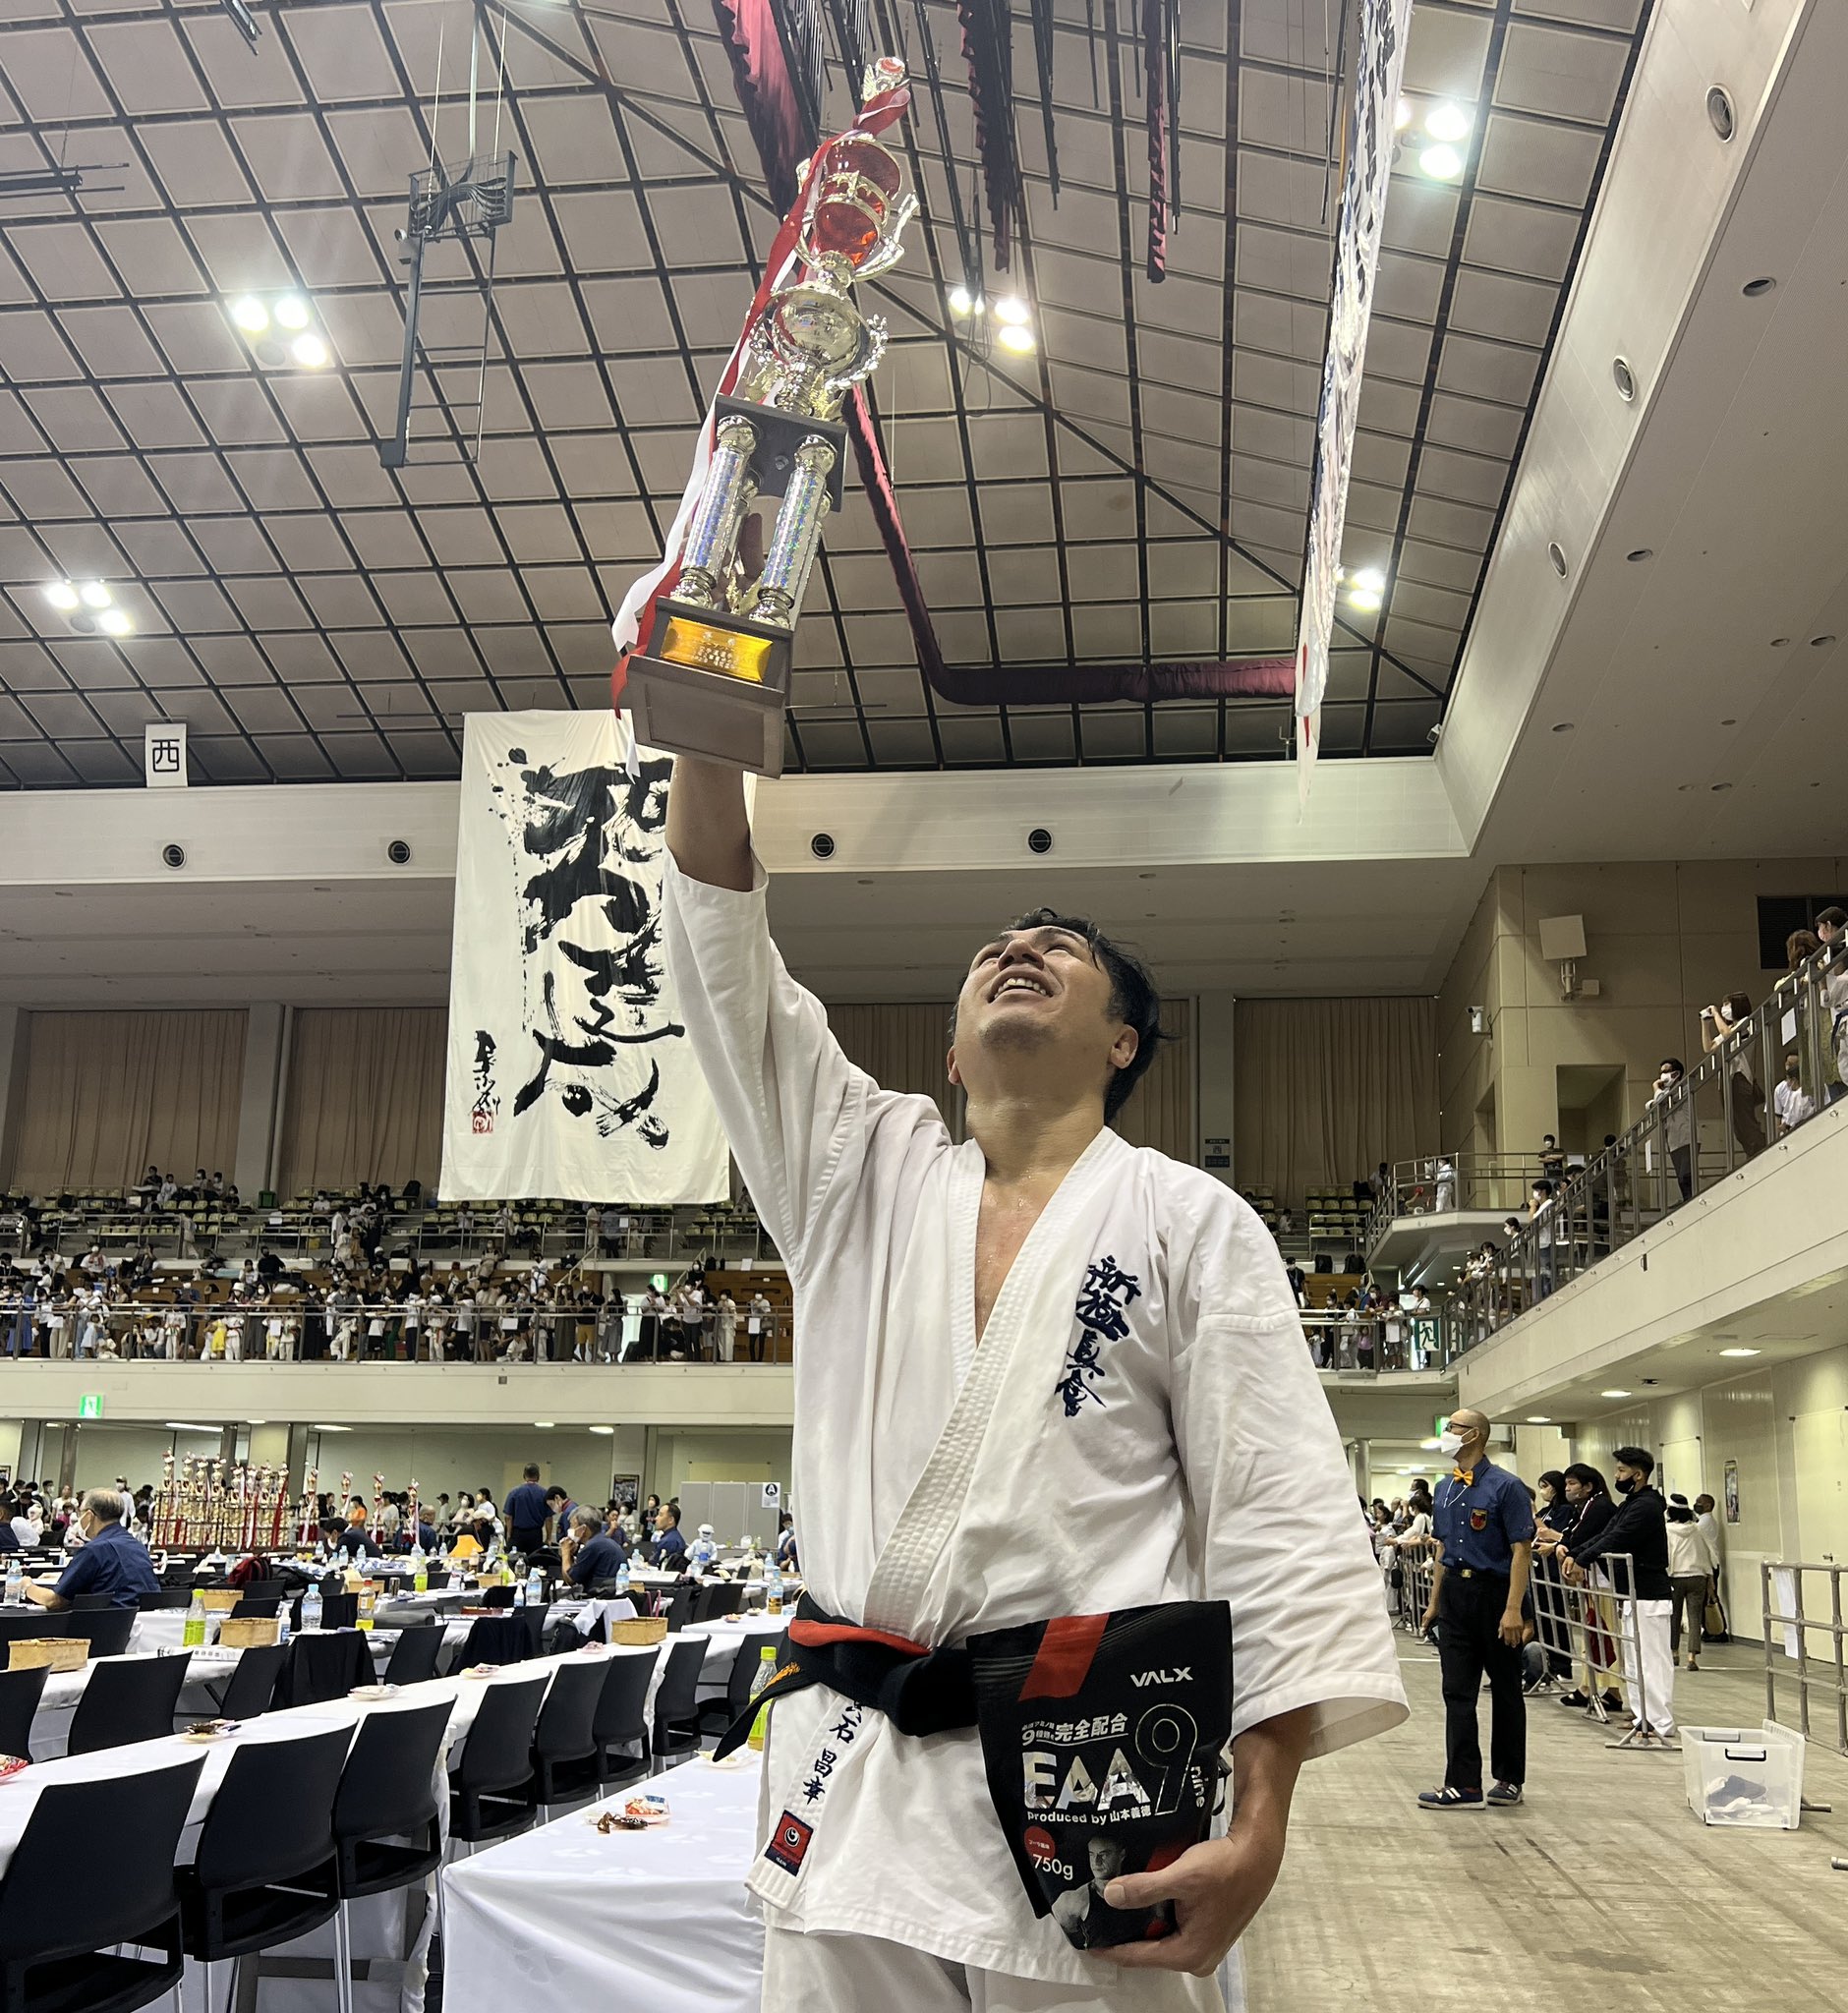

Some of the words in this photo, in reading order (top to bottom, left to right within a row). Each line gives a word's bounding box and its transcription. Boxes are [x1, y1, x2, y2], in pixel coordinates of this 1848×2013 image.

[151, 739, 180, 773] 西
[1129, 1666, 1193, 1688] VALX
[829, 1701, 862, 1744] 石
[1022, 1748, 1151, 1811] EAA
[1190, 1765, 1209, 1809] nine
[1027, 1811, 1088, 1824] produced
[1091, 1813, 1107, 1825] by
[1032, 1853, 1073, 1880] 750g
